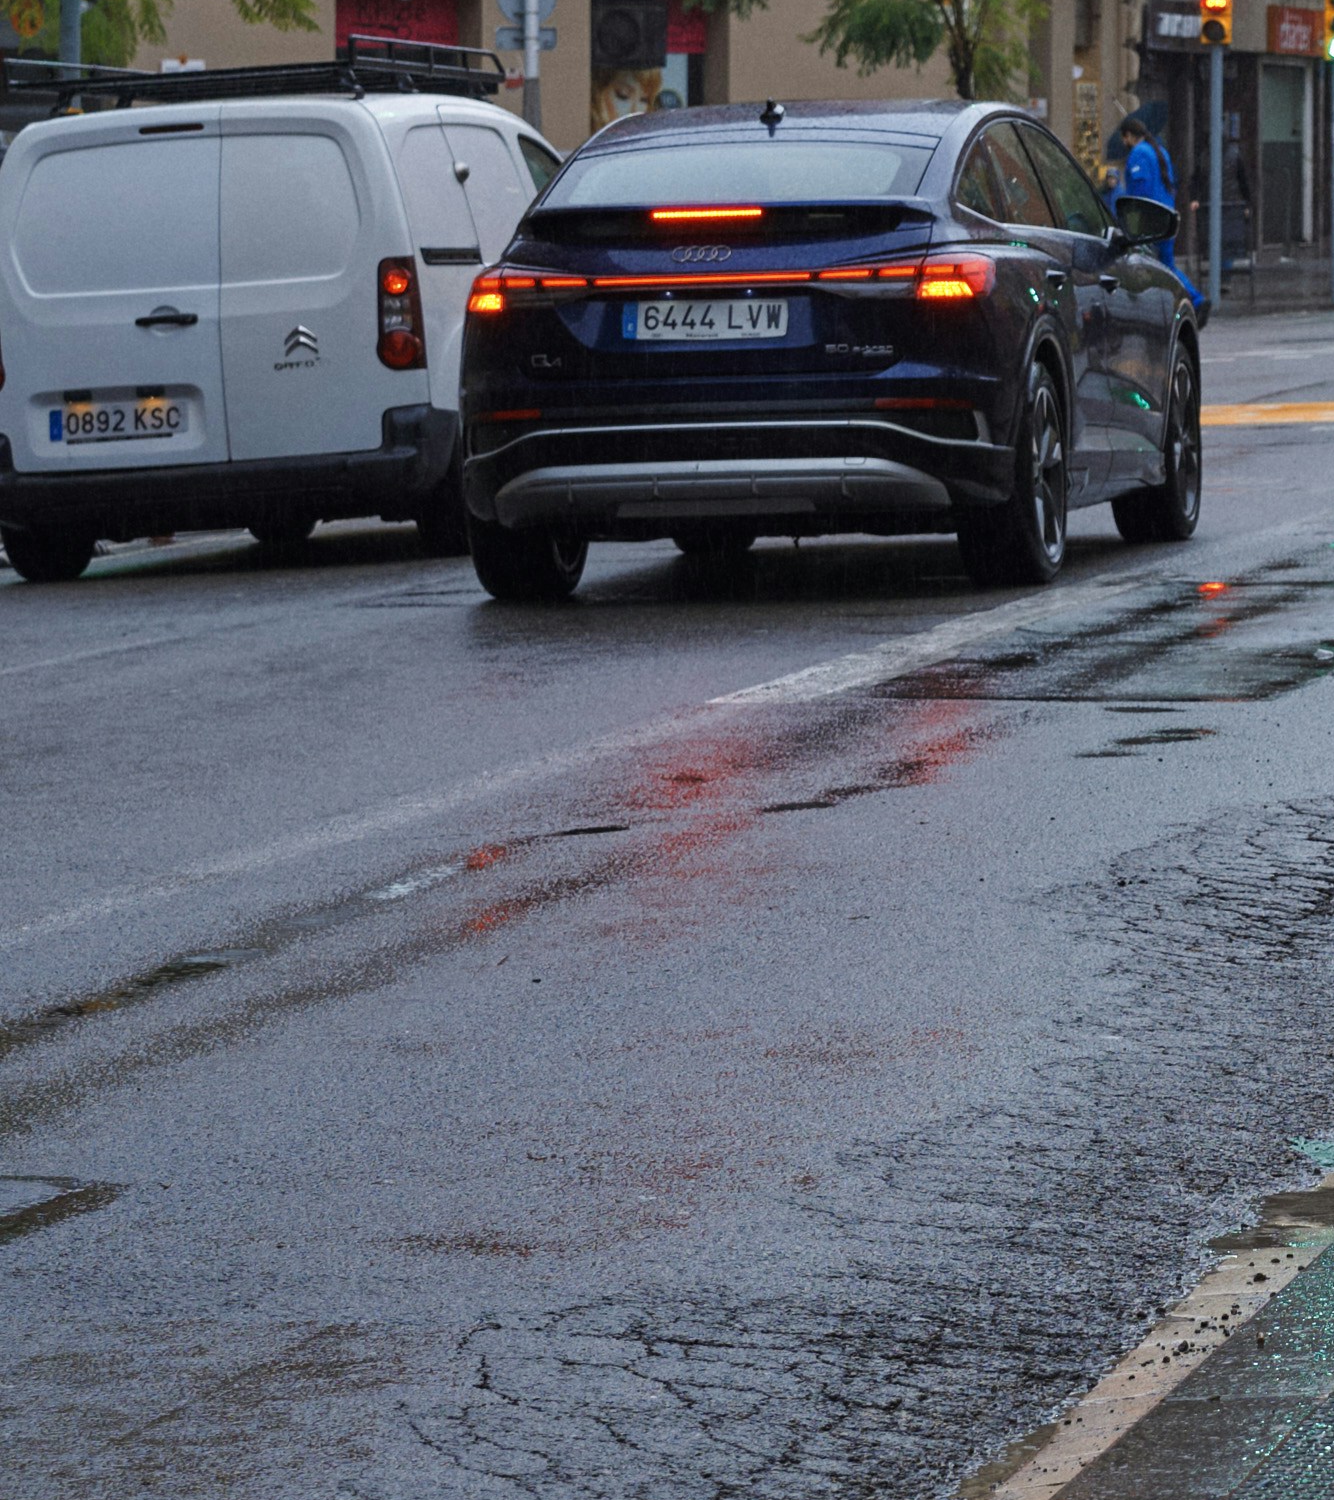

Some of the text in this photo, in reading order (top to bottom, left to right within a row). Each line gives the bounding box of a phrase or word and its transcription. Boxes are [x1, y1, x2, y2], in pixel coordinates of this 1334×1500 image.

[643, 303, 783, 331] 6444 LVW
[65, 405, 181, 435] 0892 KSC
